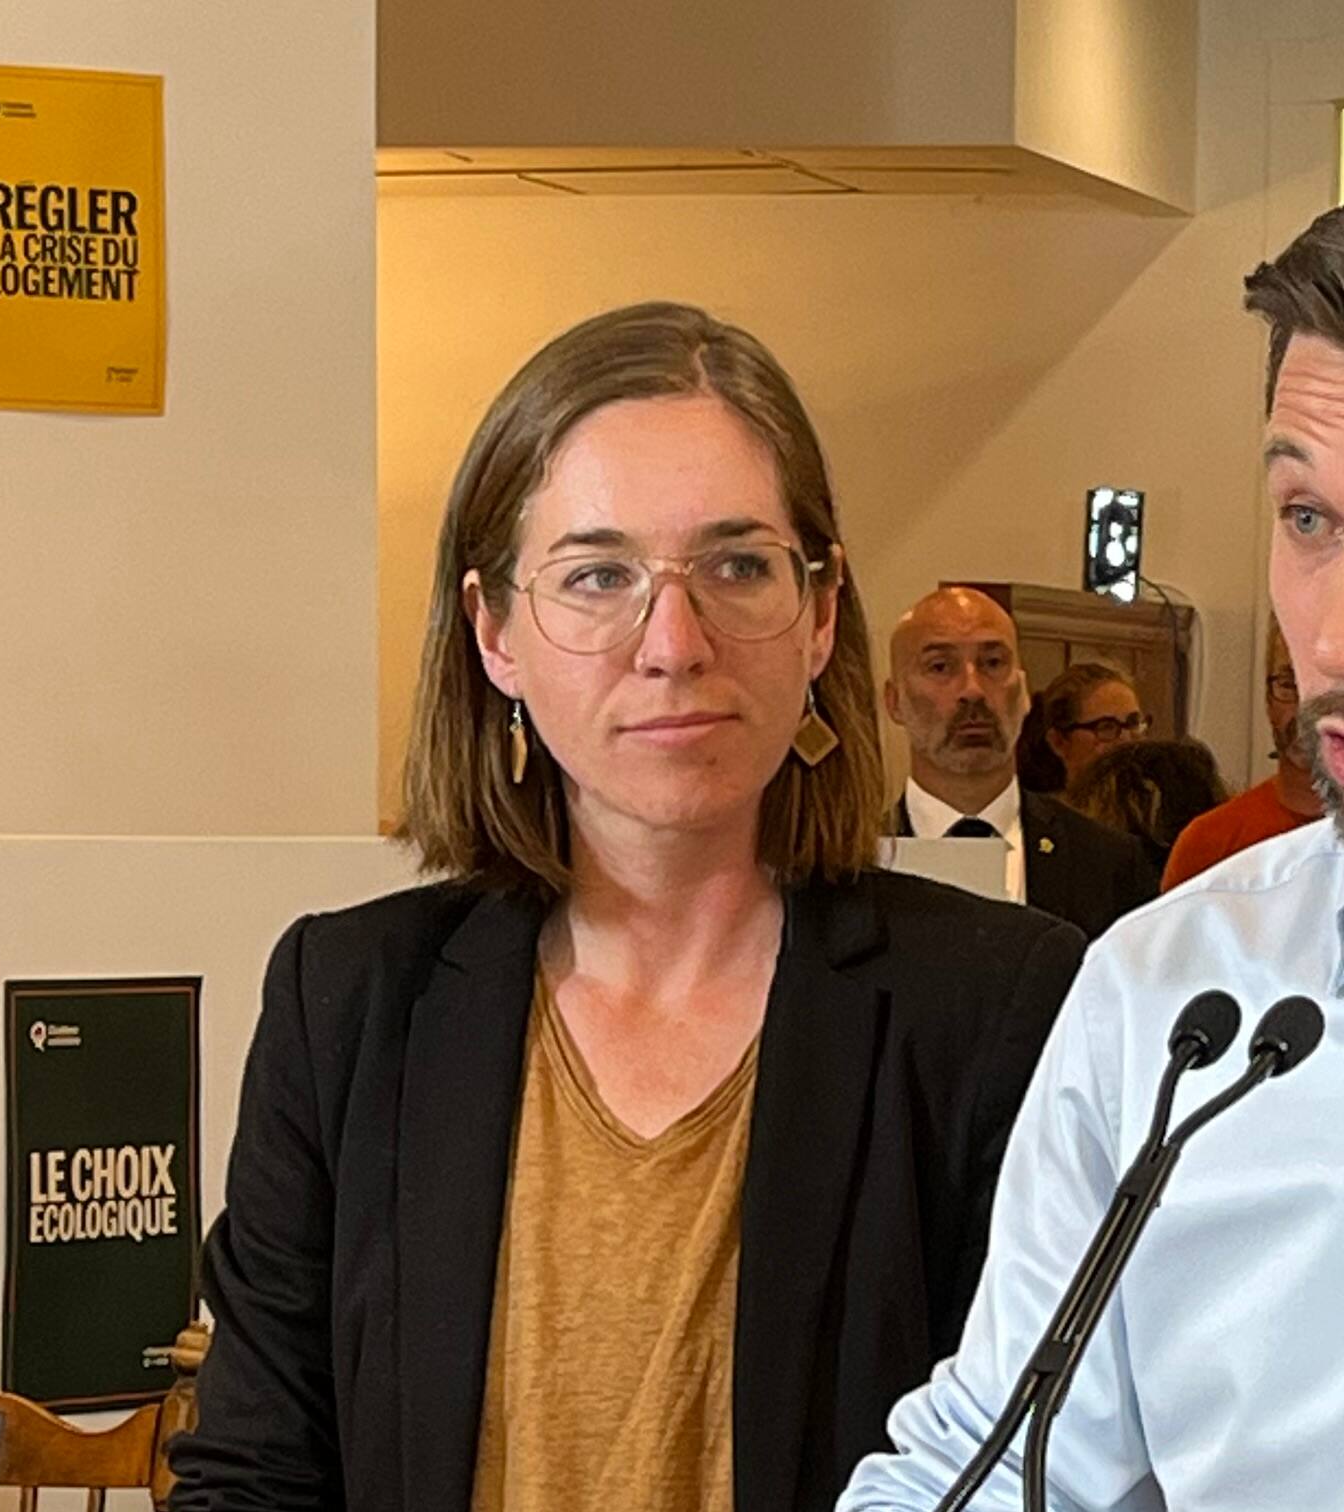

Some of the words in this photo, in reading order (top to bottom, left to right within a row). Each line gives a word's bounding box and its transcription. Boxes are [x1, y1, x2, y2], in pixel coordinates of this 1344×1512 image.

[23, 233, 97, 266] CRISE
[105, 238, 139, 268] DU
[30, 1150, 66, 1203] LE
[71, 1144, 176, 1199] CHOIX
